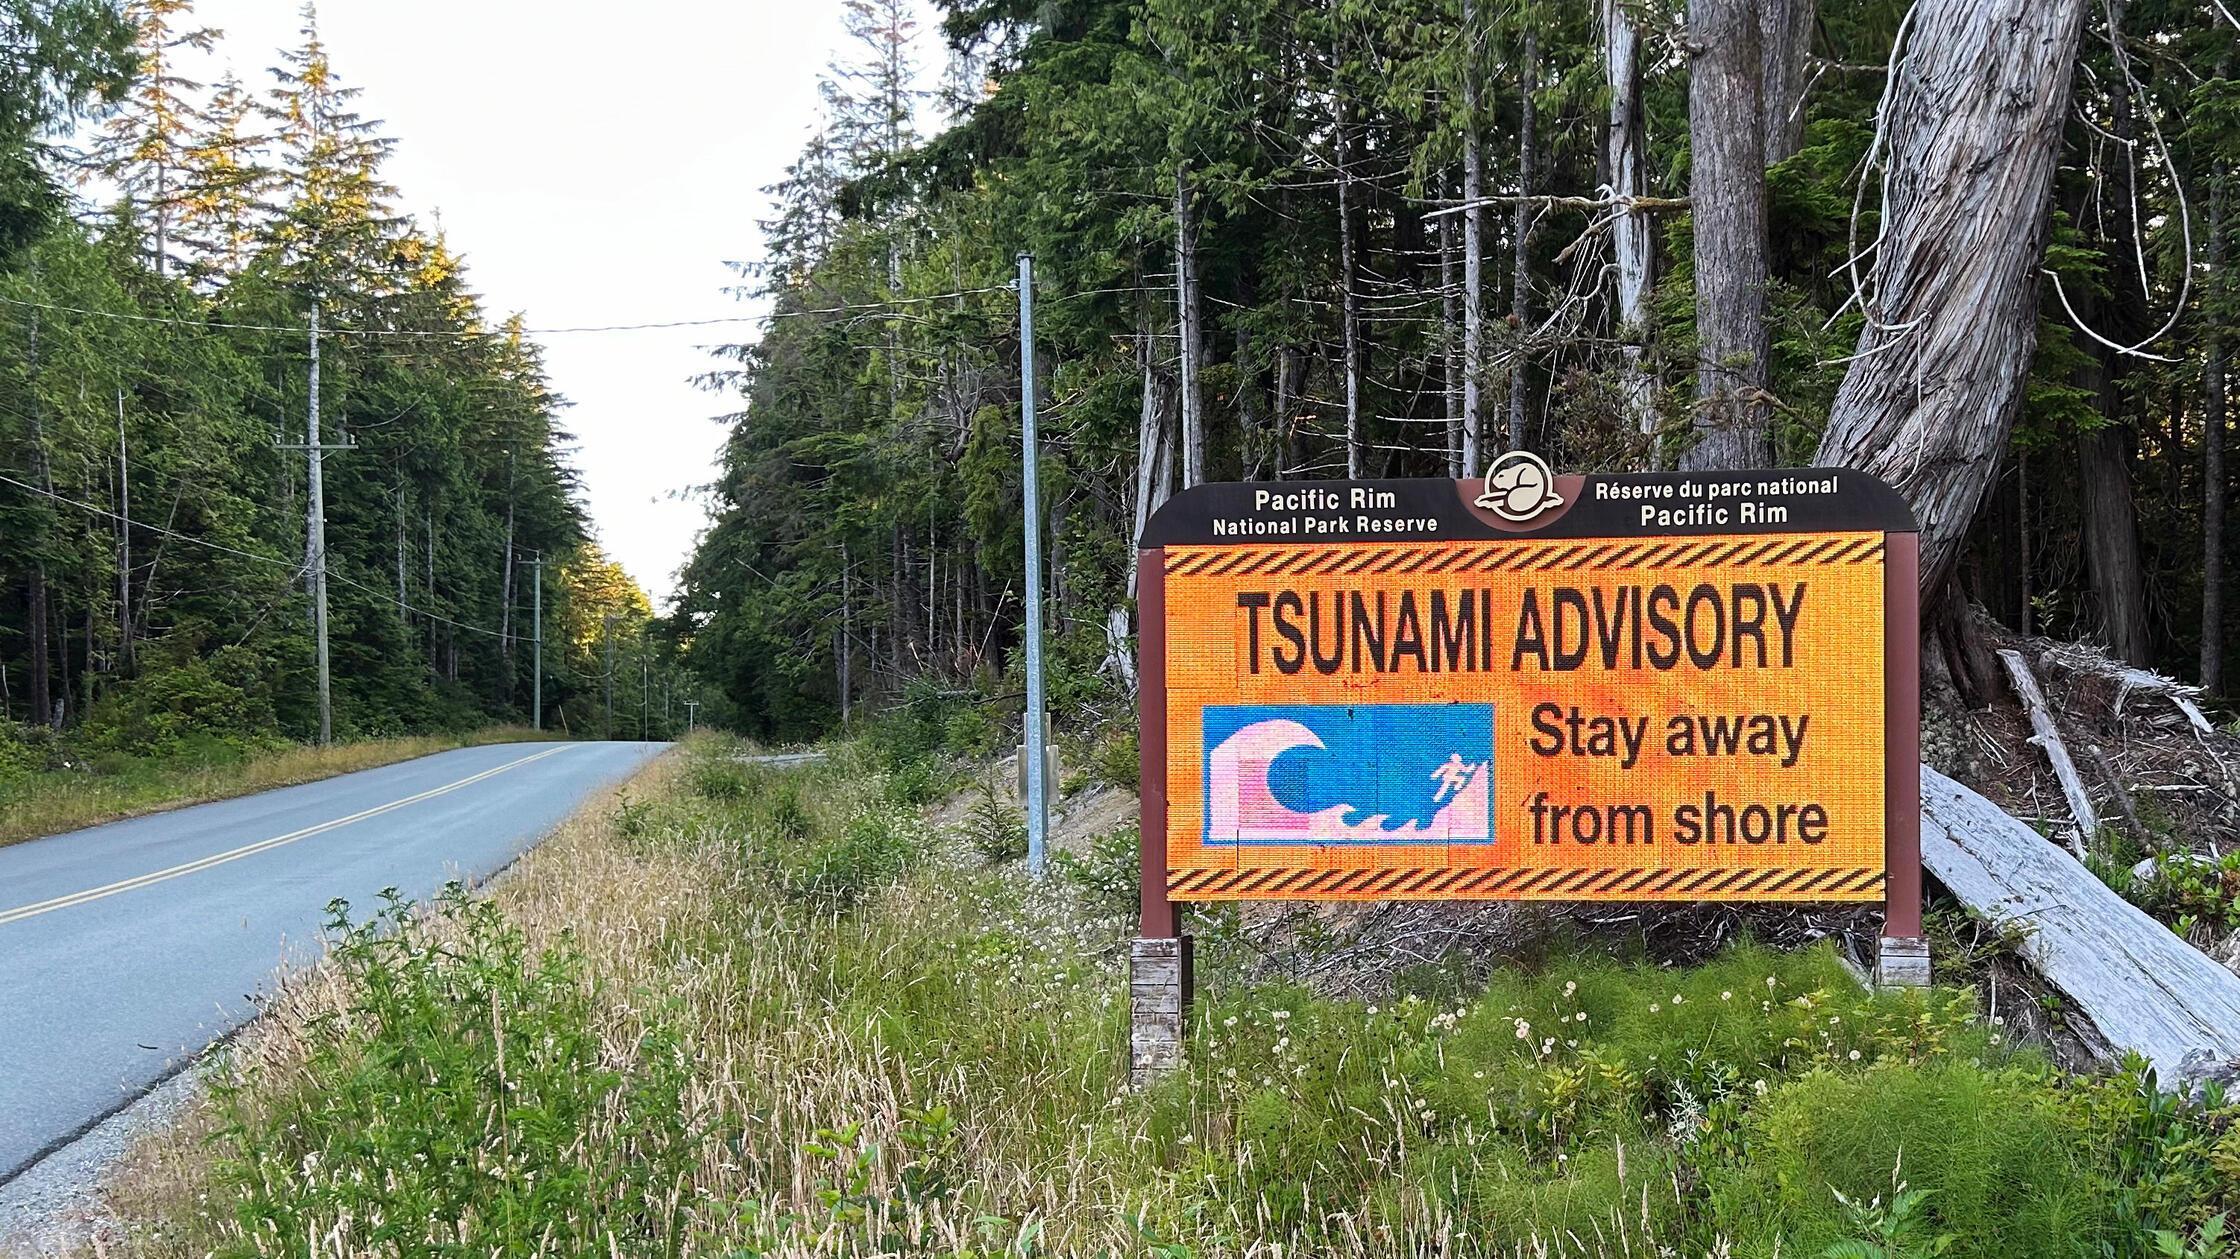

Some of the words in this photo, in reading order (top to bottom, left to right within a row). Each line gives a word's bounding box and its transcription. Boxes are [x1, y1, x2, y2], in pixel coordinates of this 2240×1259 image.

[1255, 489, 1340, 511] Pacific
[1350, 488, 1396, 510] Rim
[1596, 481, 1673, 500] Réserve
[1680, 480, 1702, 498] du
[1708, 482, 1752, 501] parc
[1757, 476, 1838, 495] national
[1212, 518, 1297, 536] National
[1305, 517, 1350, 534] Park
[1356, 515, 1438, 532] Reserve
[1641, 504, 1729, 526] Pacific
[1740, 502, 1788, 524] Rim
[1238, 589, 1492, 676] TSUNAMI
[1512, 582, 1807, 672] ADVISORY
[1530, 702, 1648, 768] Stay
[1666, 713, 1808, 767] away
[1530, 792, 1653, 845] from
[1674, 792, 1828, 845] shore
